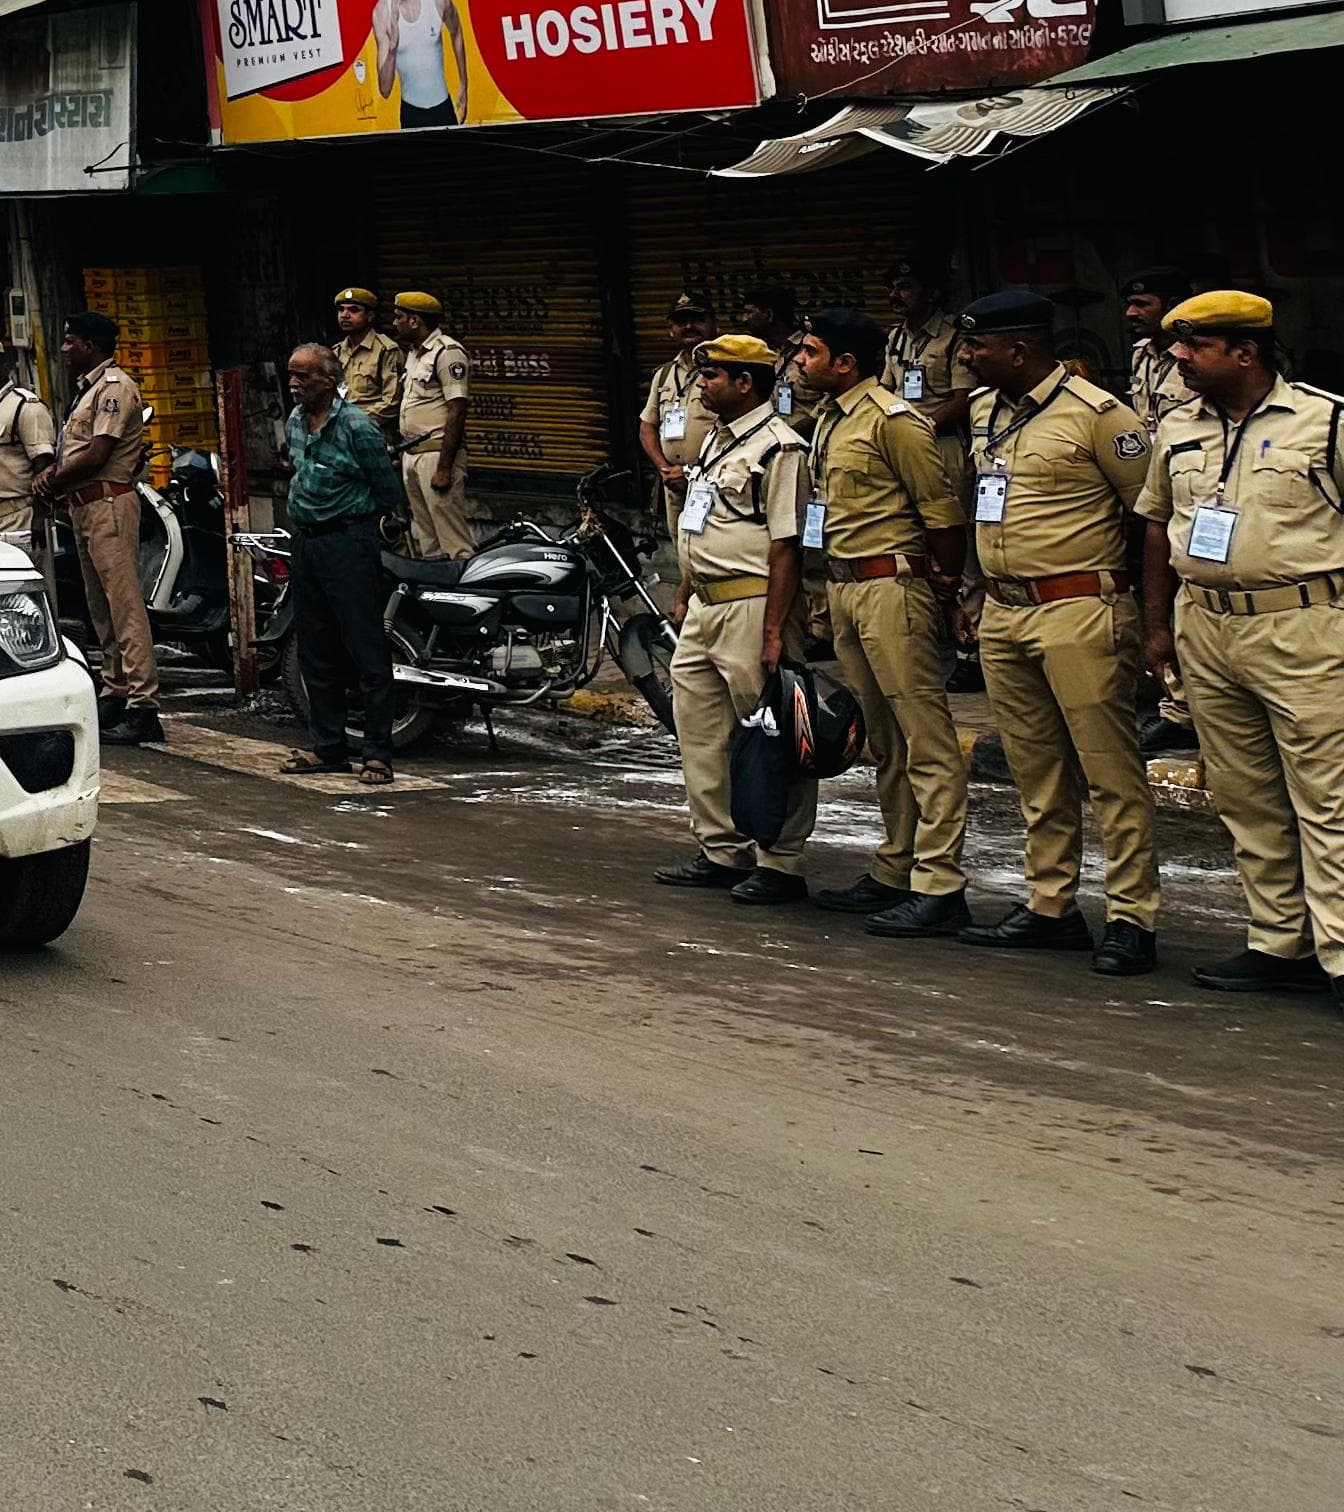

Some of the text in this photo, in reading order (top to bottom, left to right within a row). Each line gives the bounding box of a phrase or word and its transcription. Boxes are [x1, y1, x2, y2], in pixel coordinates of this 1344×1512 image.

[236, 47, 322, 68] PREMIUM VEST
[533, 551, 559, 562] Hero
